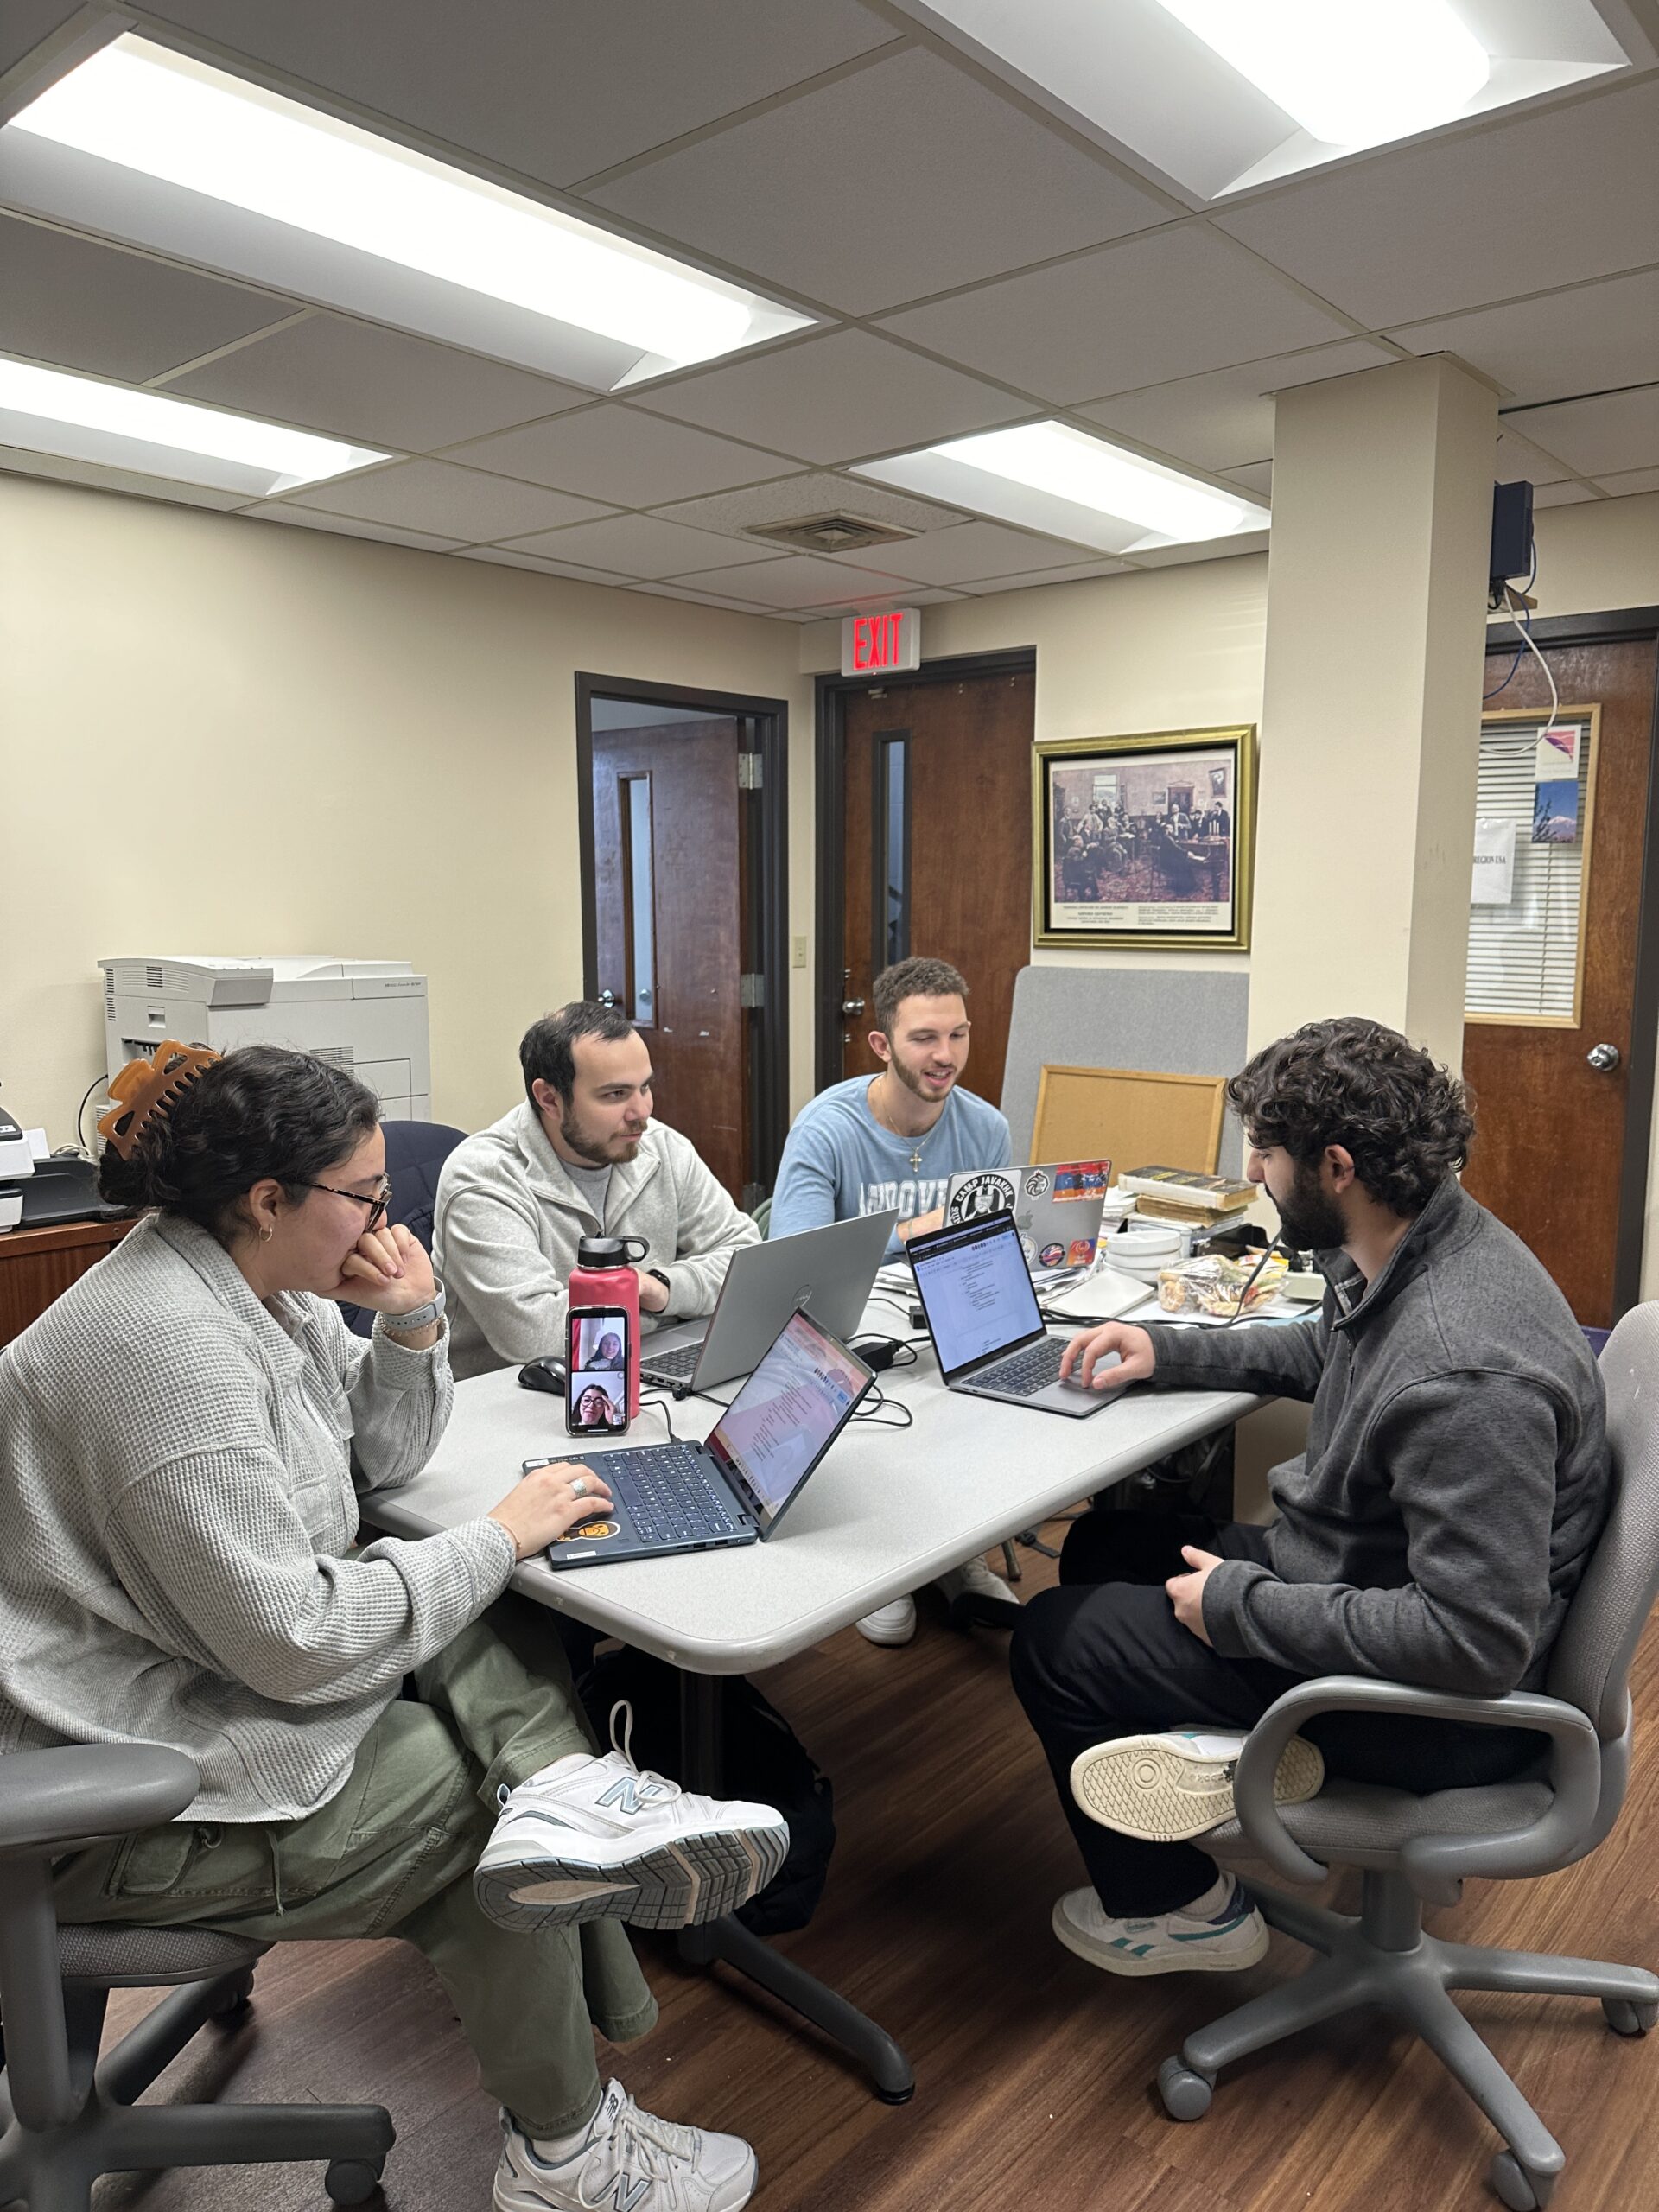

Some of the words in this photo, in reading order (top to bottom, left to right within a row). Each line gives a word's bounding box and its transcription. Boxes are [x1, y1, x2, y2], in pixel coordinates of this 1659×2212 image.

[854, 613, 903, 670] EXIT
[955, 1179, 979, 1202] CAMP
[981, 1176, 1014, 1198] JAVAKHK
